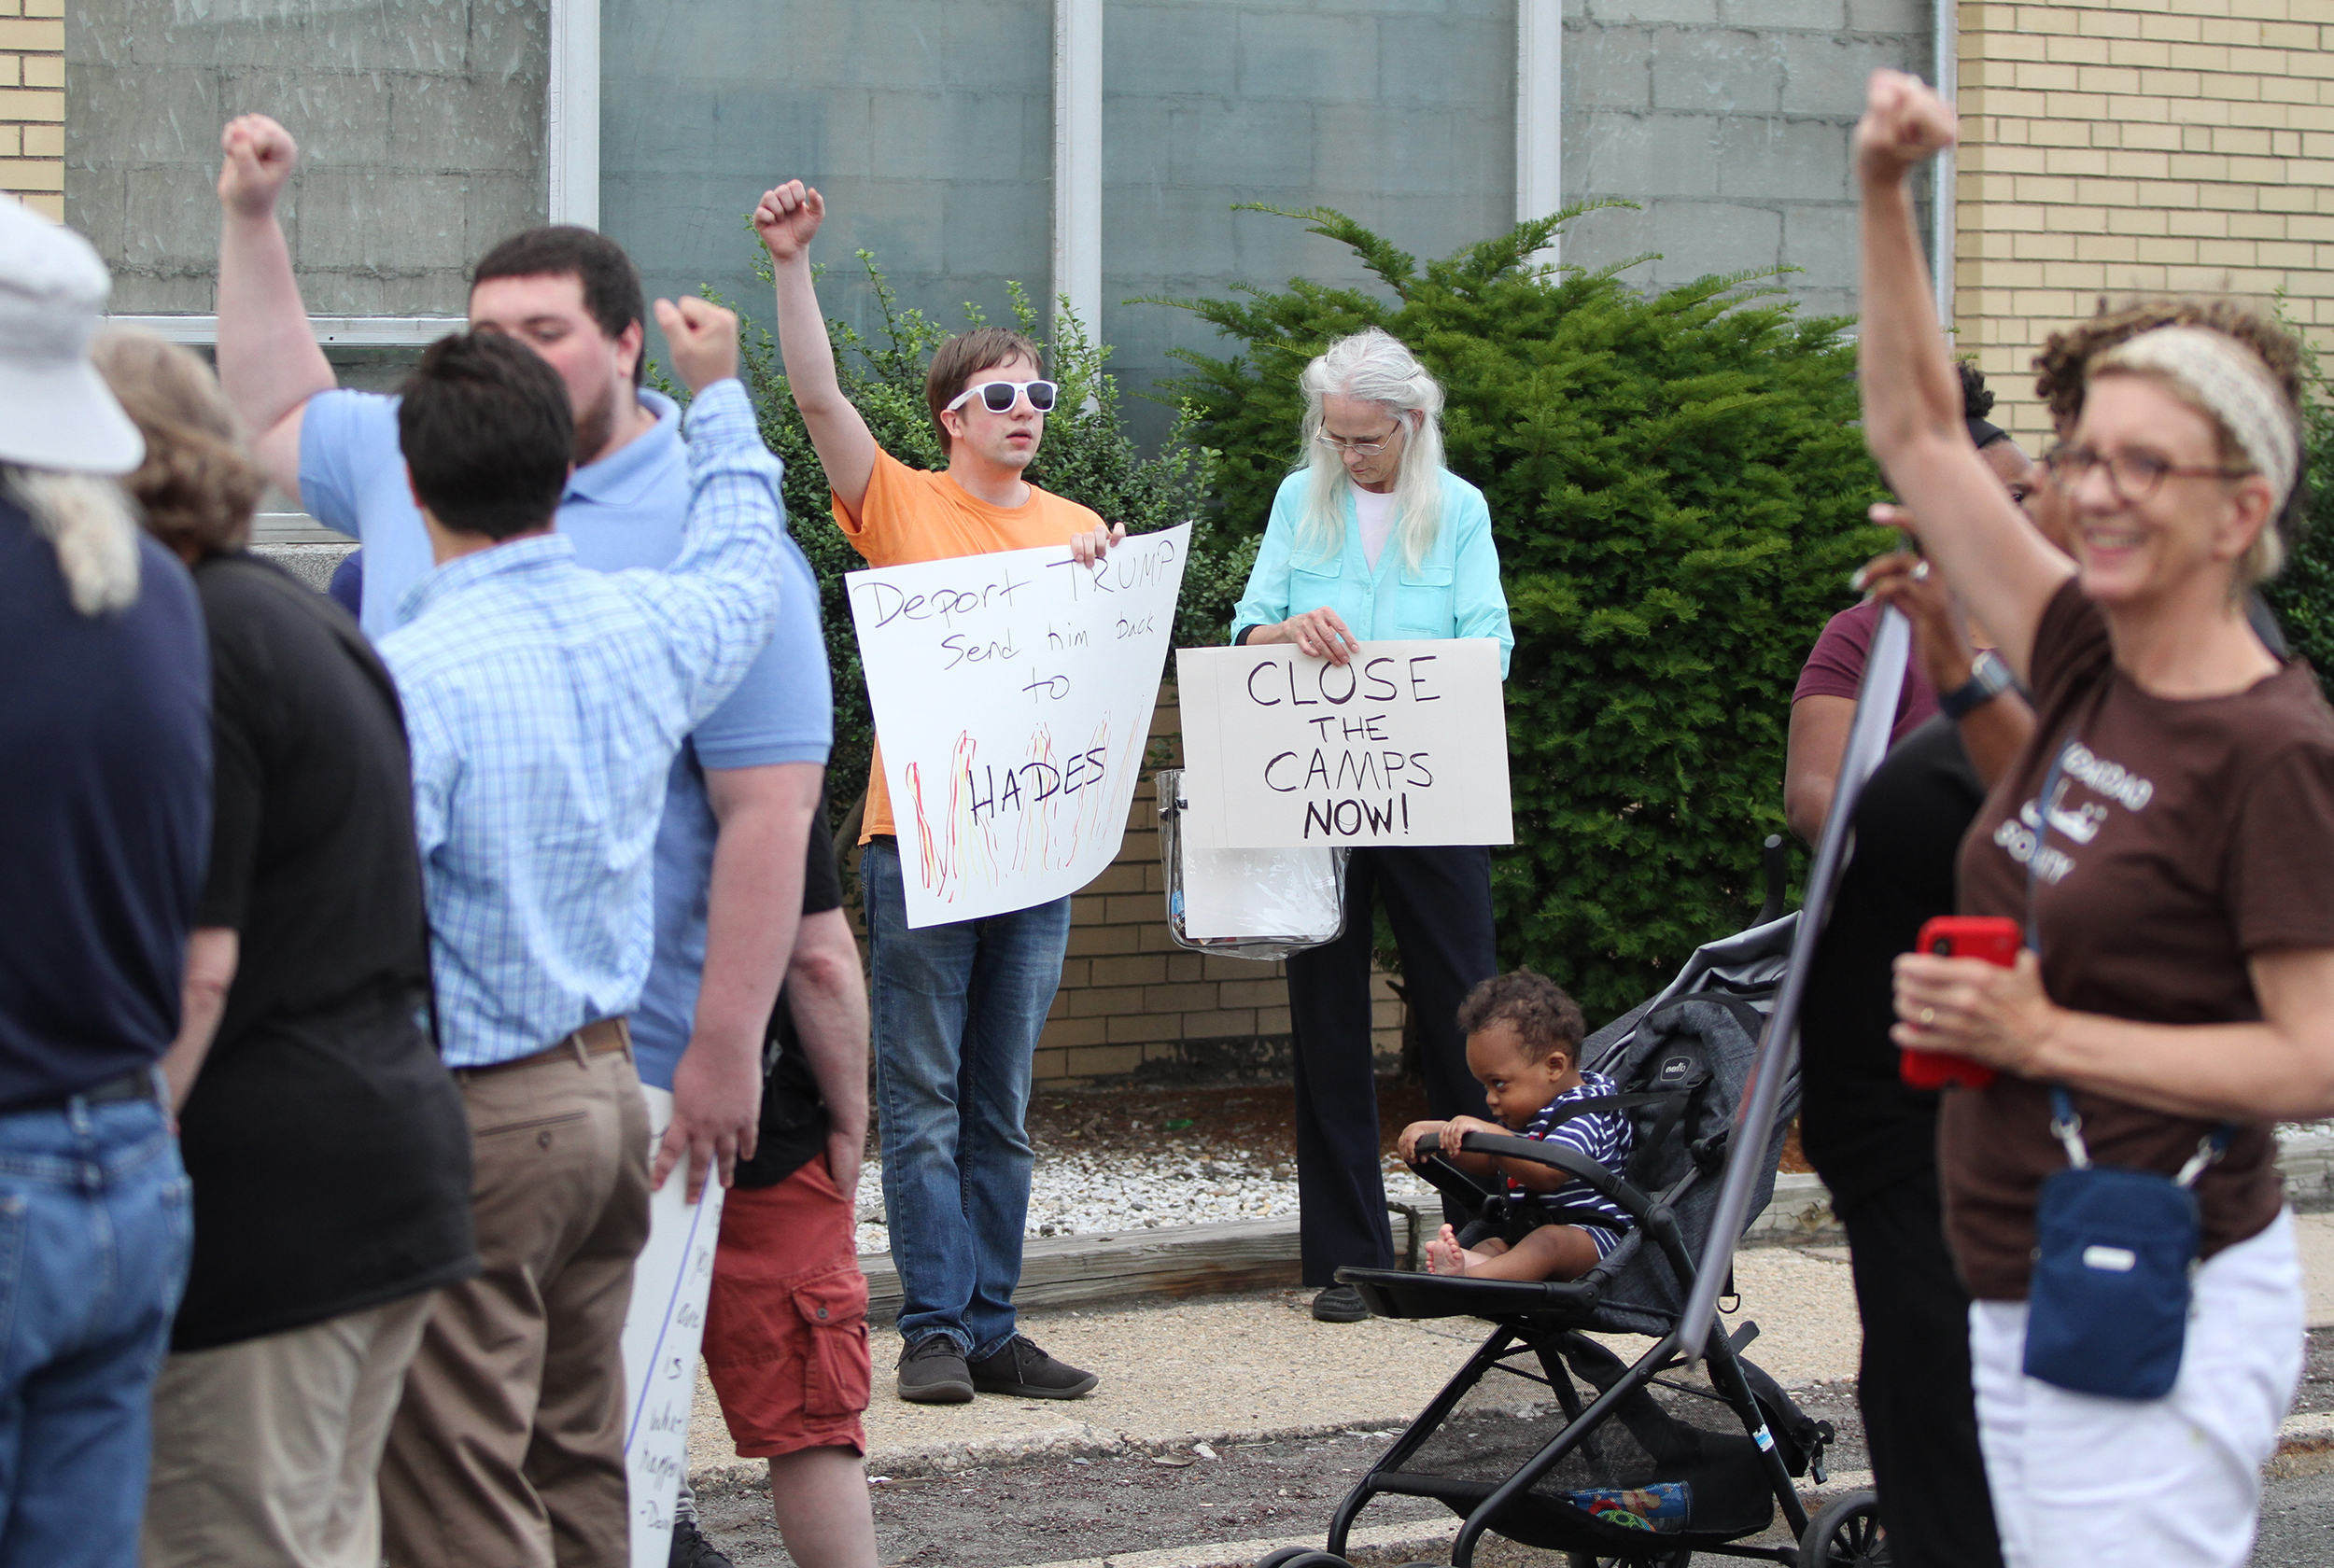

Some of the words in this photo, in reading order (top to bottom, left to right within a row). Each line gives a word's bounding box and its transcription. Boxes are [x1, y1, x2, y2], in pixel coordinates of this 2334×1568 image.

[852, 567, 1033, 629] Deport
[1046, 539, 1175, 602] TRUMP
[1047, 622, 1089, 651] him
[1116, 609, 1154, 640] back
[1021, 666, 1071, 705] to
[1247, 655, 1441, 707] CLOSE
[1308, 714, 1389, 743] THE
[968, 747, 1106, 826] HADES
[1264, 747, 1435, 792] CAMPS
[1303, 791, 1410, 840] NOW!
[662, 1343, 683, 1380] is
